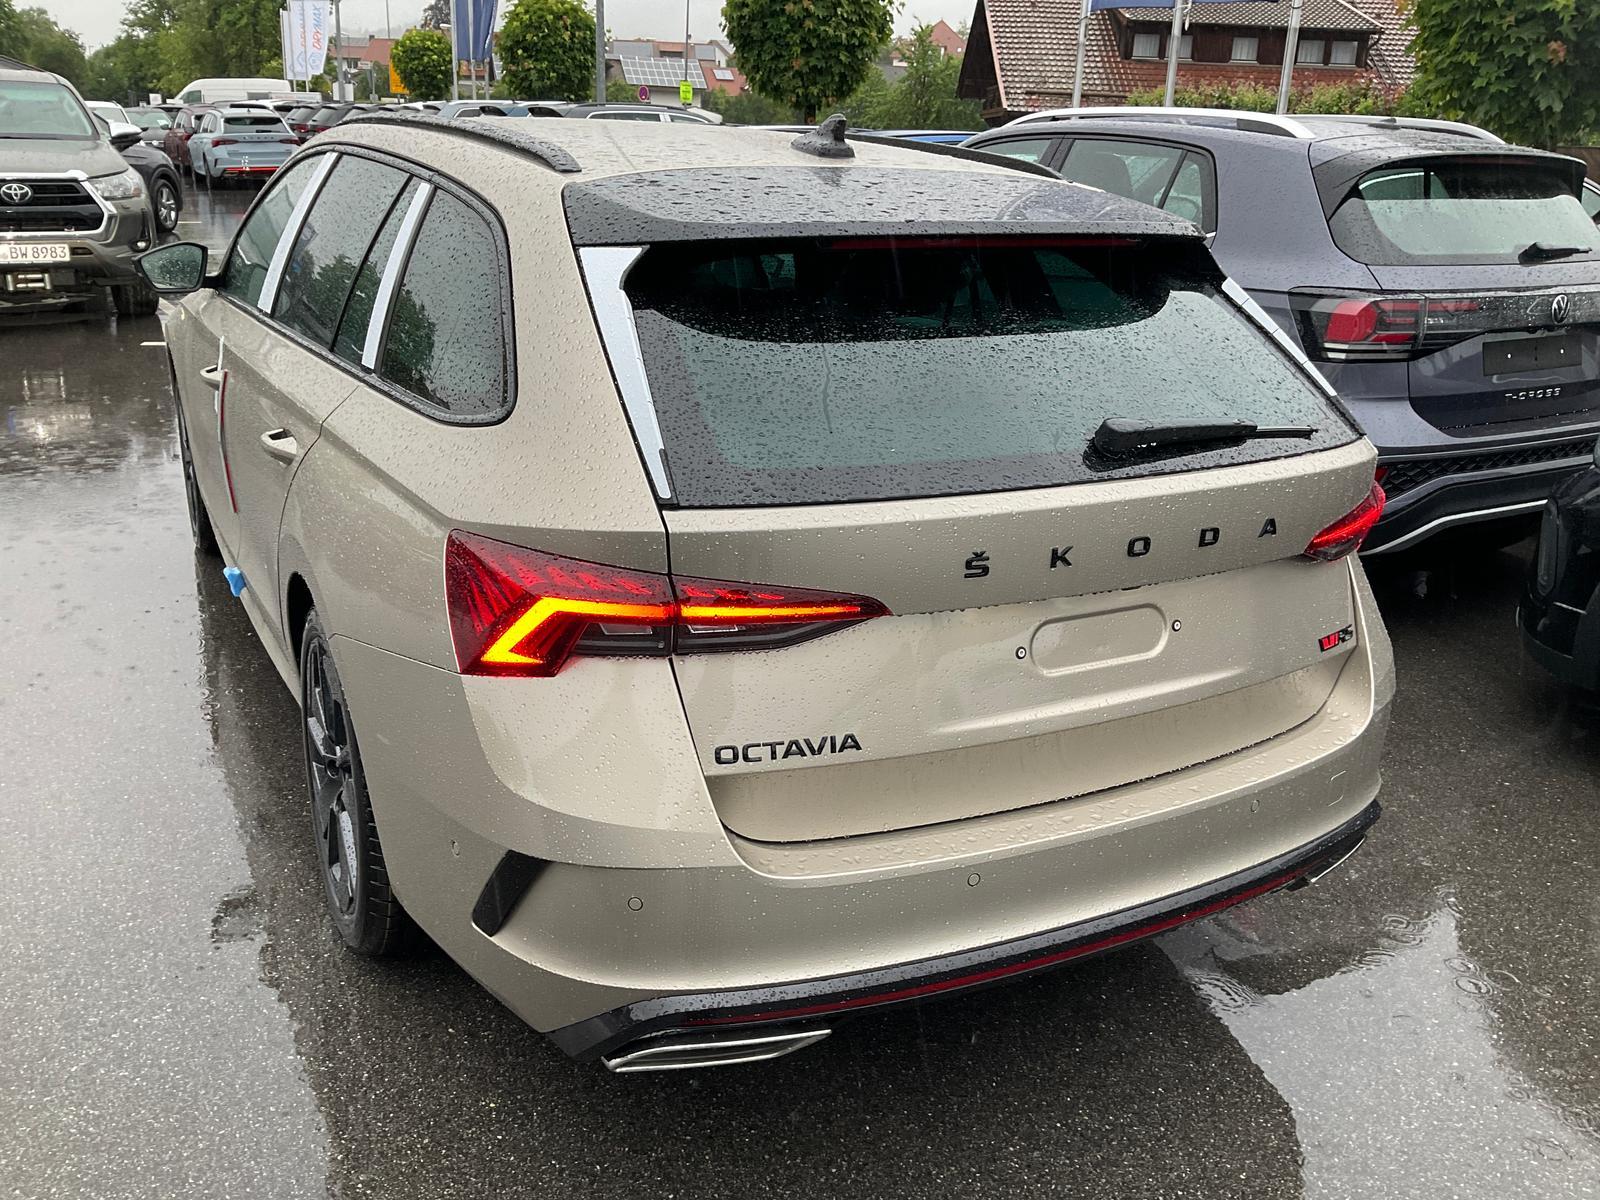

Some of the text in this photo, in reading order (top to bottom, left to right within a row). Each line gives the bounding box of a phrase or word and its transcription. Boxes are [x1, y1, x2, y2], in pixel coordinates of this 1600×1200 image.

[9, 246, 67, 259] BW 8983
[1504, 387, 1561, 400] T-CROSS
[963, 518, 1277, 578] ŠKODA
[714, 733, 863, 765] OCTAVIA
